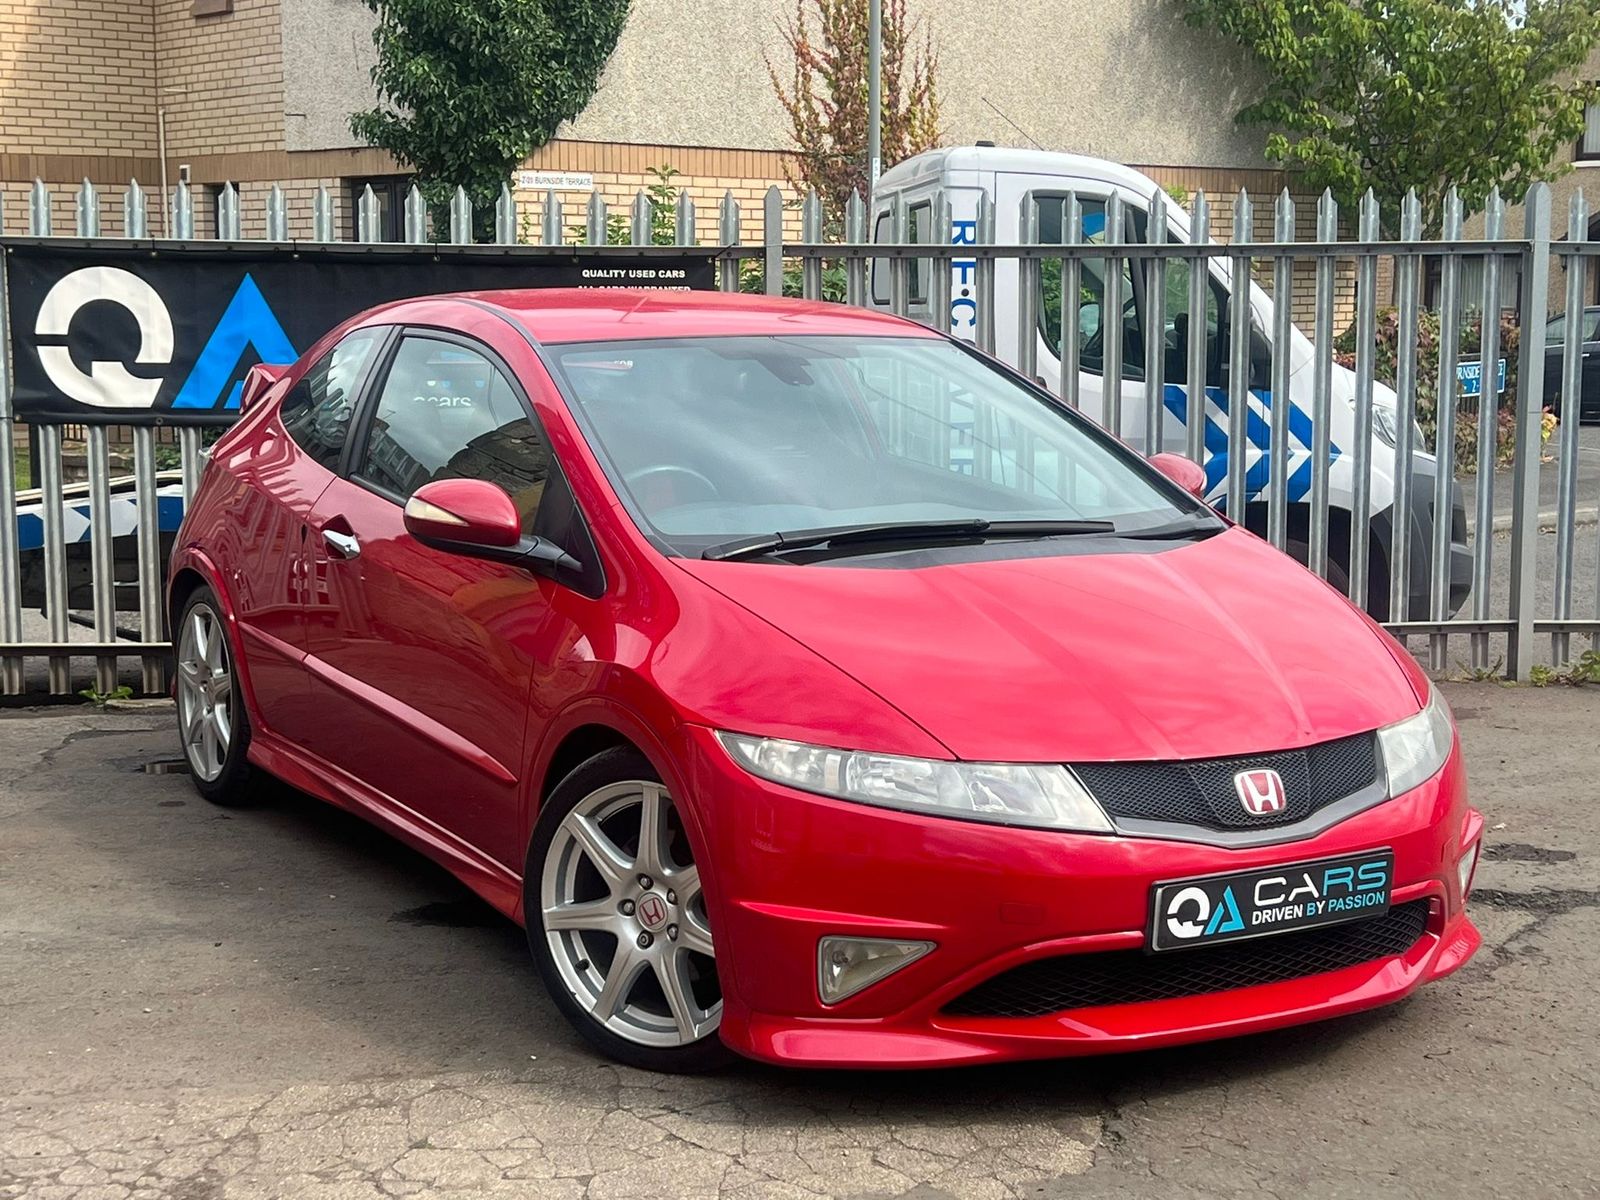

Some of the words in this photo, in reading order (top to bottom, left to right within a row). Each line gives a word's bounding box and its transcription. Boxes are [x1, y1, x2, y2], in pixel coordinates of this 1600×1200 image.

[534, 176, 564, 186] BURNSIDE
[565, 177, 591, 186] TERRACE
[582, 269, 626, 278] QUALITY
[628, 270, 656, 278] USED
[658, 270, 686, 278] CARS
[35, 266, 300, 409] QA
[1253, 860, 1388, 907] CARS
[1166, 886, 1246, 939] QA
[1251, 903, 1304, 926] DRIVEN
[1306, 900, 1326, 917] BY
[1327, 891, 1386, 913] PASSION
